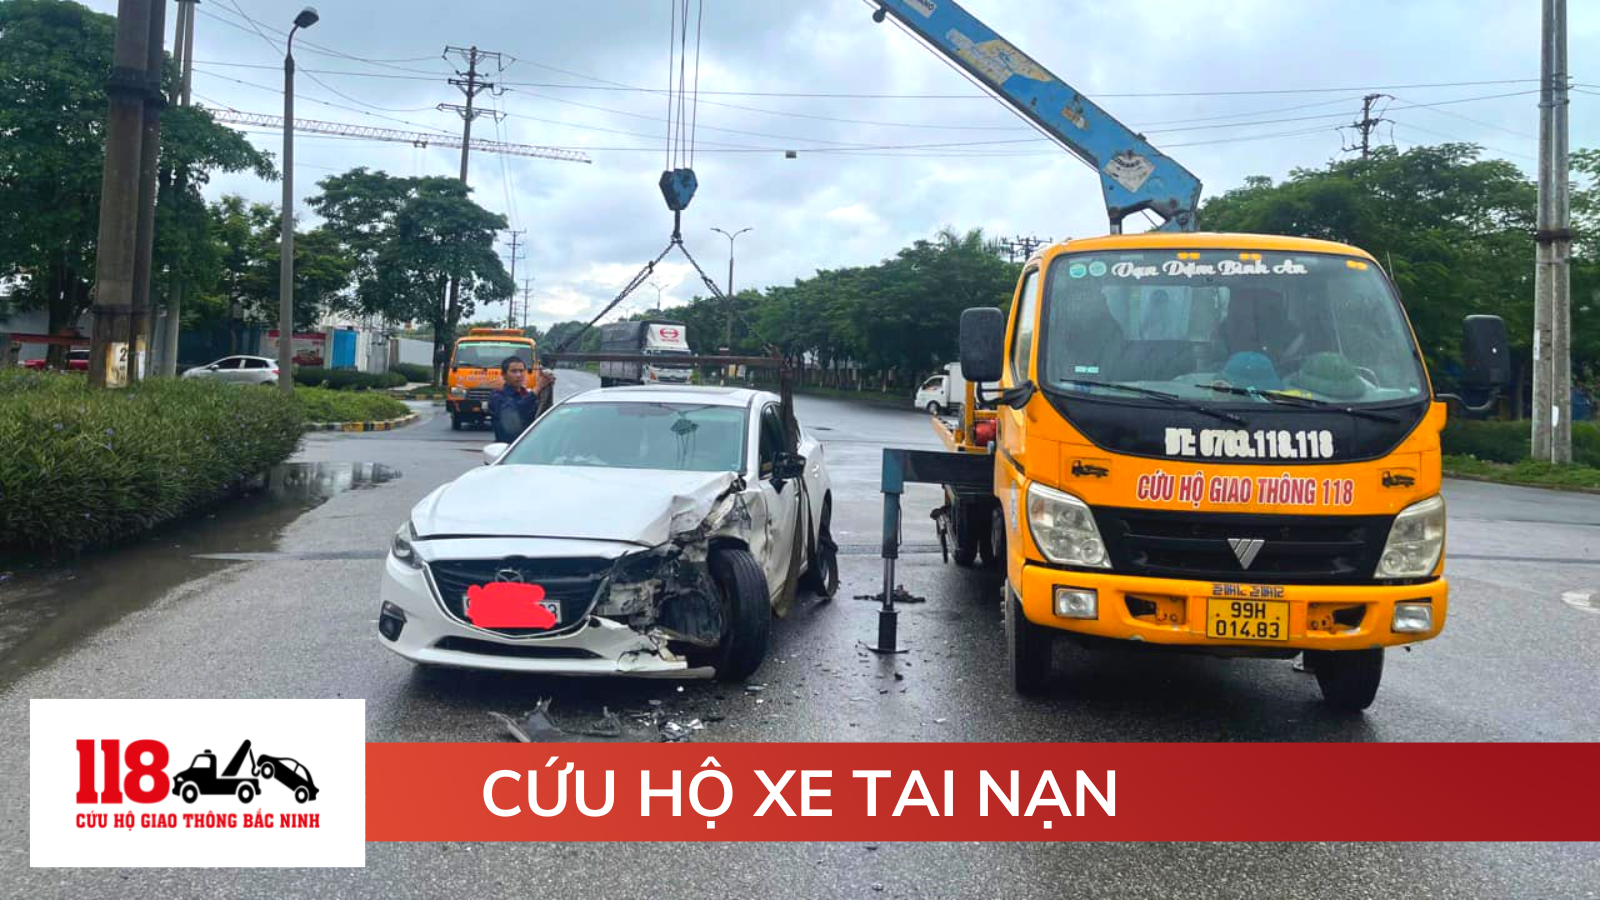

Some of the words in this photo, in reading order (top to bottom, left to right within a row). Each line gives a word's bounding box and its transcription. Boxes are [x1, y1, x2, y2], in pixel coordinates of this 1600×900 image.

[1273, 259, 1309, 274] An
[1138, 470, 1174, 501] CỨU
[1179, 470, 1205, 508] HỘ
[1209, 476, 1252, 503] GIAO
[1258, 472, 1316, 505] THÔNG
[1322, 479, 1354, 505] 118
[1231, 602, 1265, 619] 99H
[1216, 619, 1280, 638] 014.83
